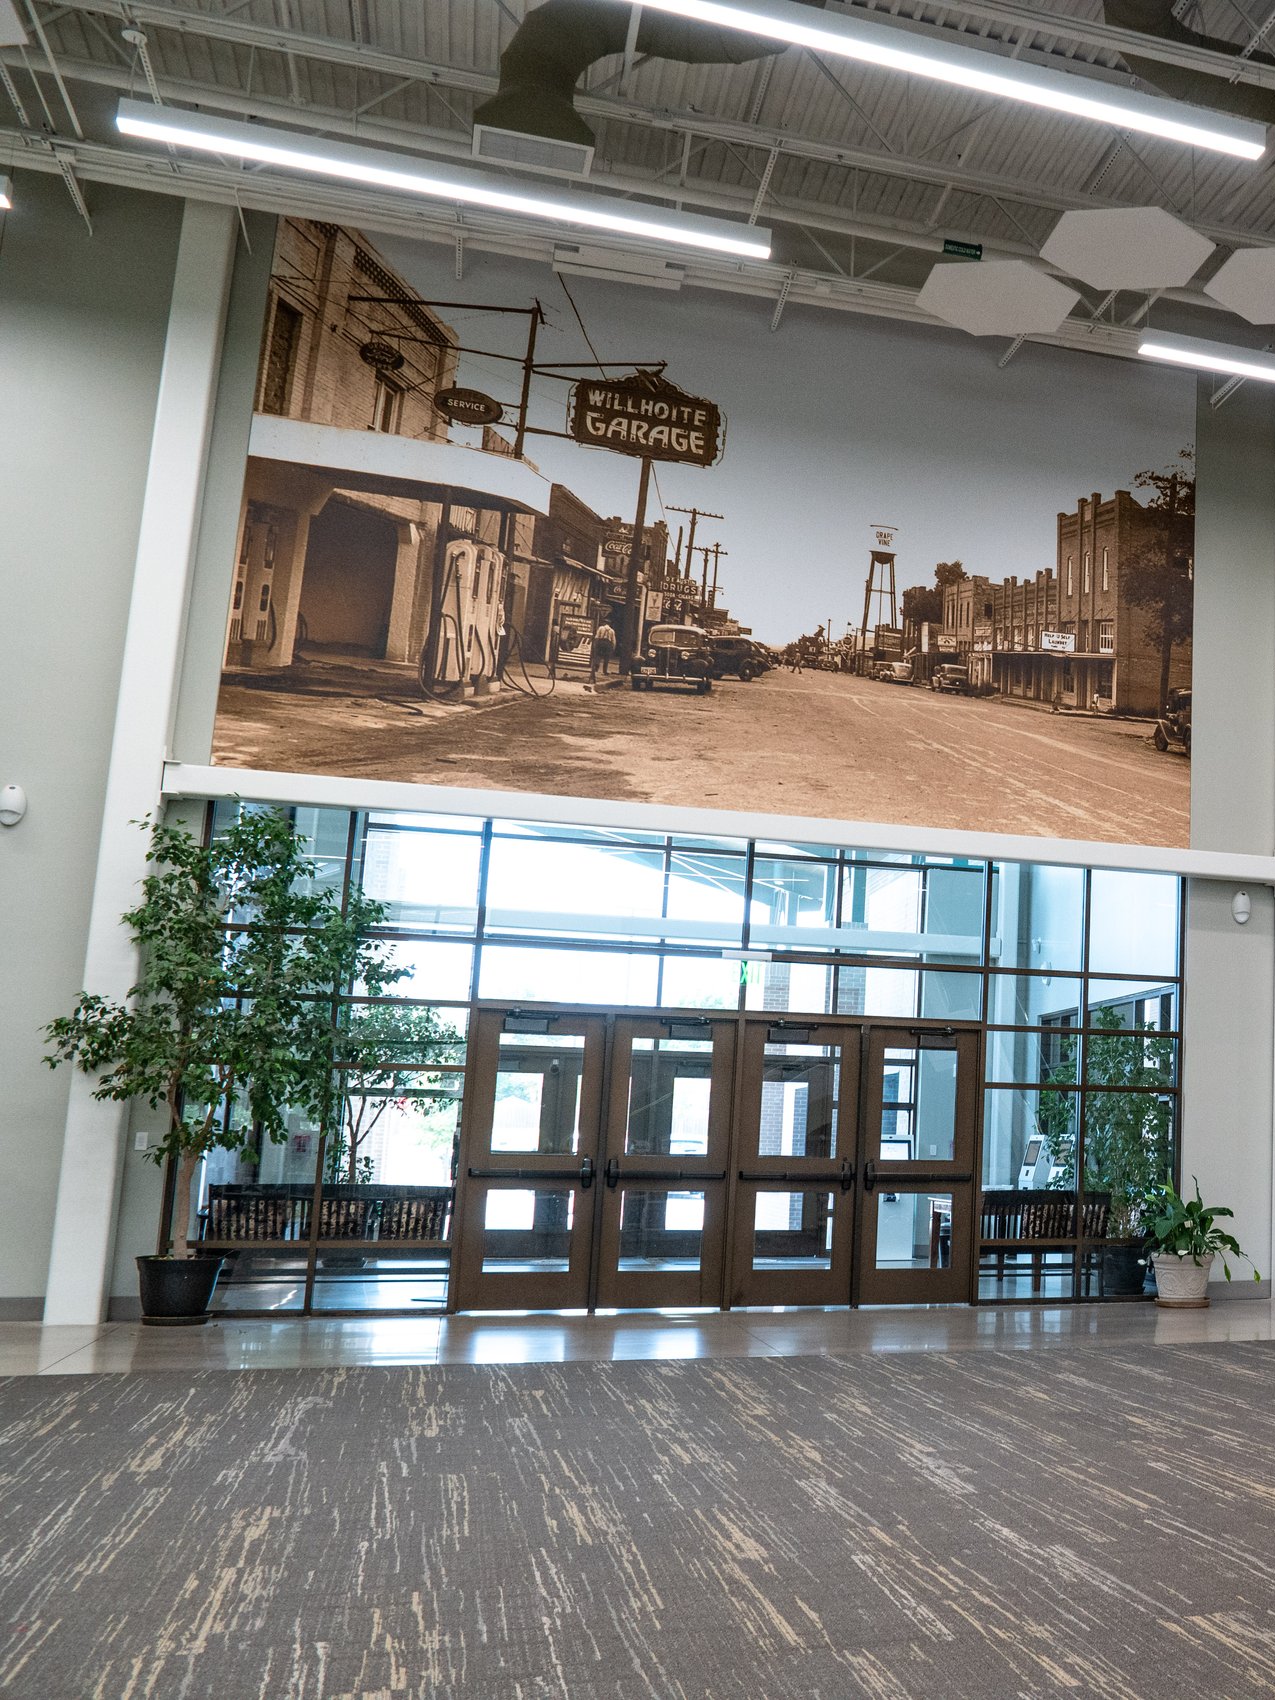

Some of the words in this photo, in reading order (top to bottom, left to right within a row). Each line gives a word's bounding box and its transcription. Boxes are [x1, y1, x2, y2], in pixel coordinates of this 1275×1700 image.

[447, 398, 486, 412] SERVICE
[588, 388, 706, 427] WILLHOITE
[585, 411, 705, 455] GARAGE
[875, 531, 893, 541] GRAPE
[878, 539, 890, 547] VINE
[662, 582, 697, 595] DRUGS
